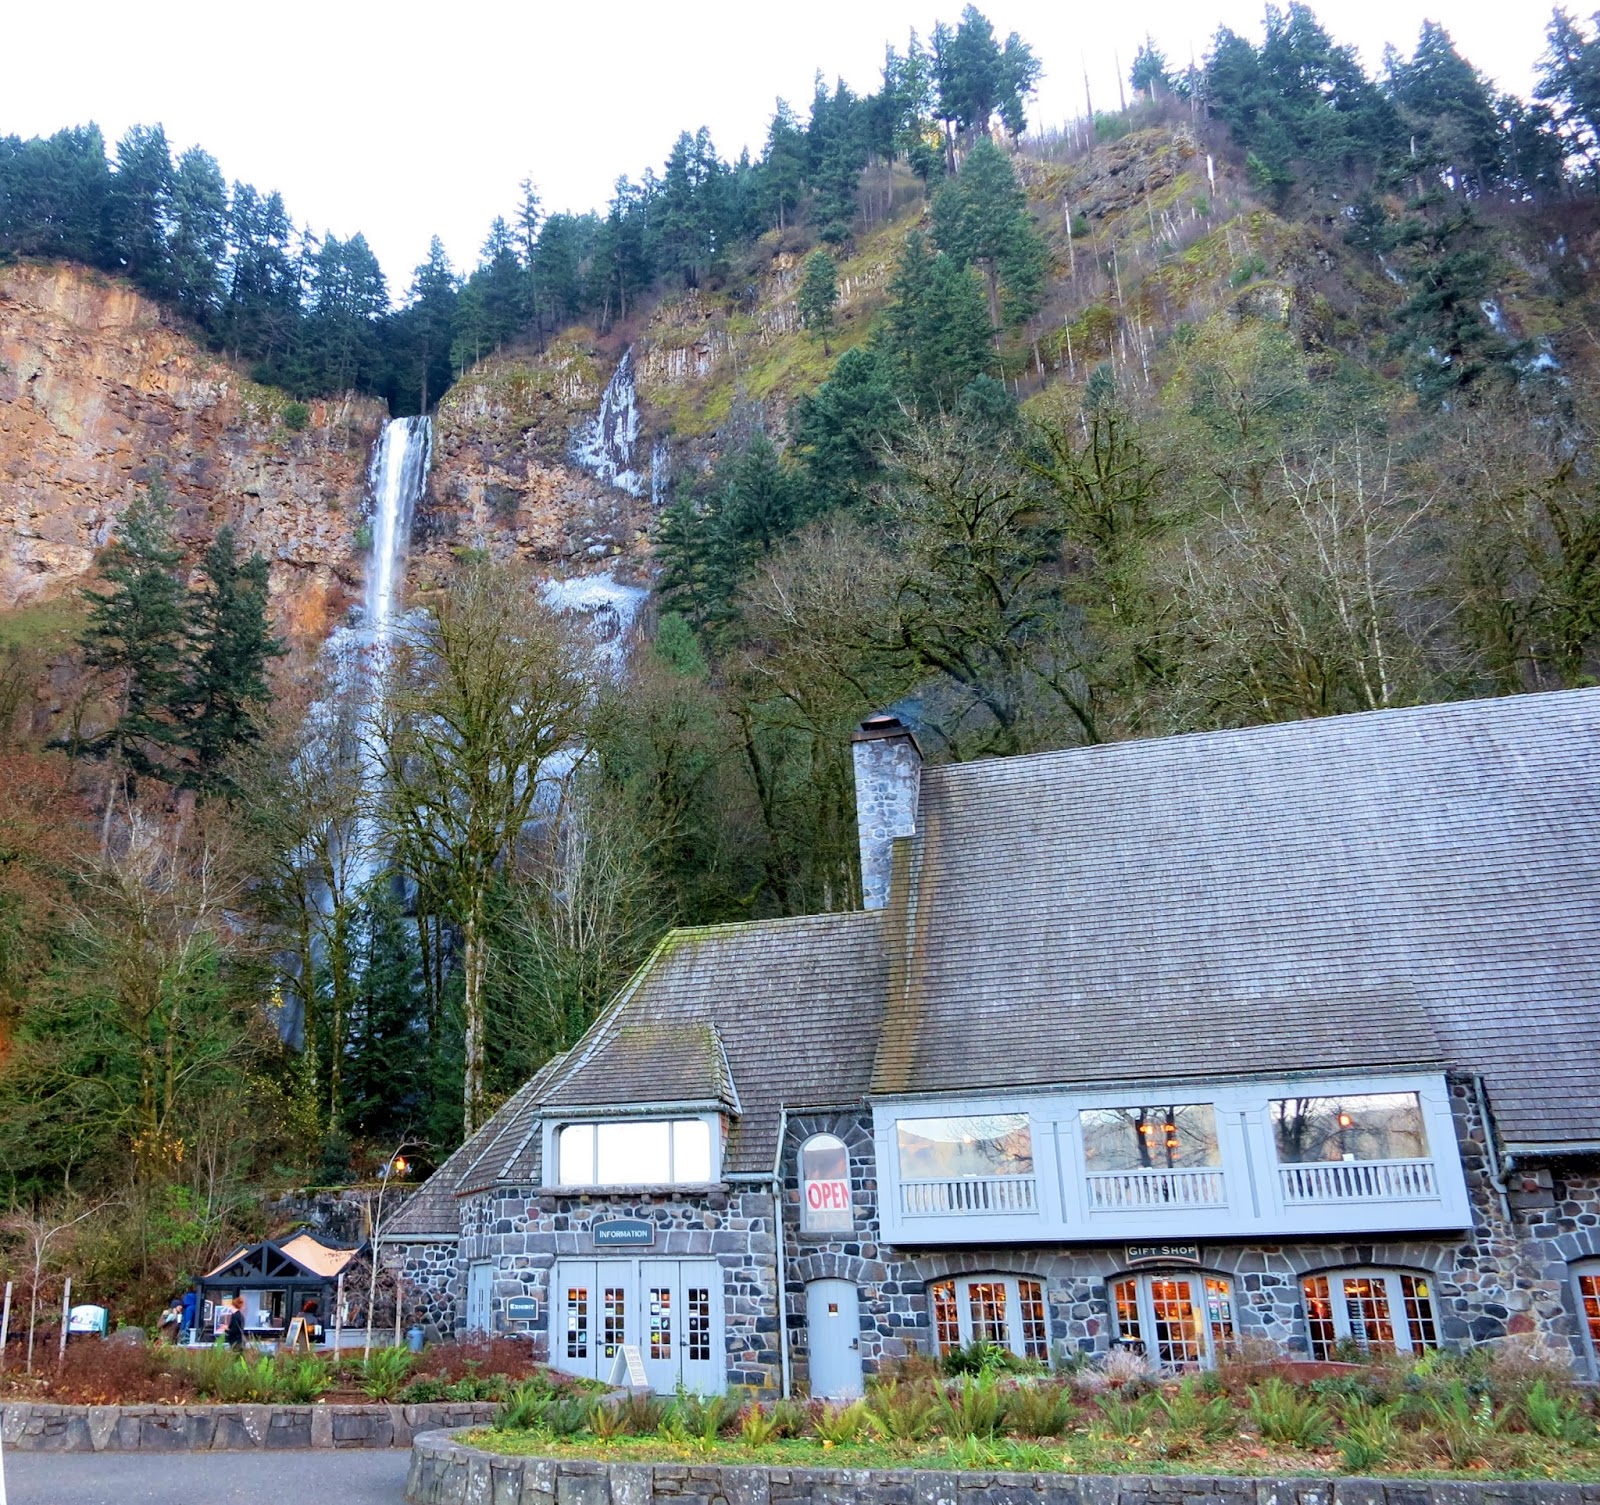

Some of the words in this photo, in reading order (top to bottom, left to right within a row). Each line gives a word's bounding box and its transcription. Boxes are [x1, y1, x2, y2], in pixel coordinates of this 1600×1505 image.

[808, 1182, 849, 1209] OPEN
[599, 1229, 648, 1239] INFORMATION
[1128, 1246, 1157, 1256] GIFT
[1161, 1245, 1196, 1255] SHOP
